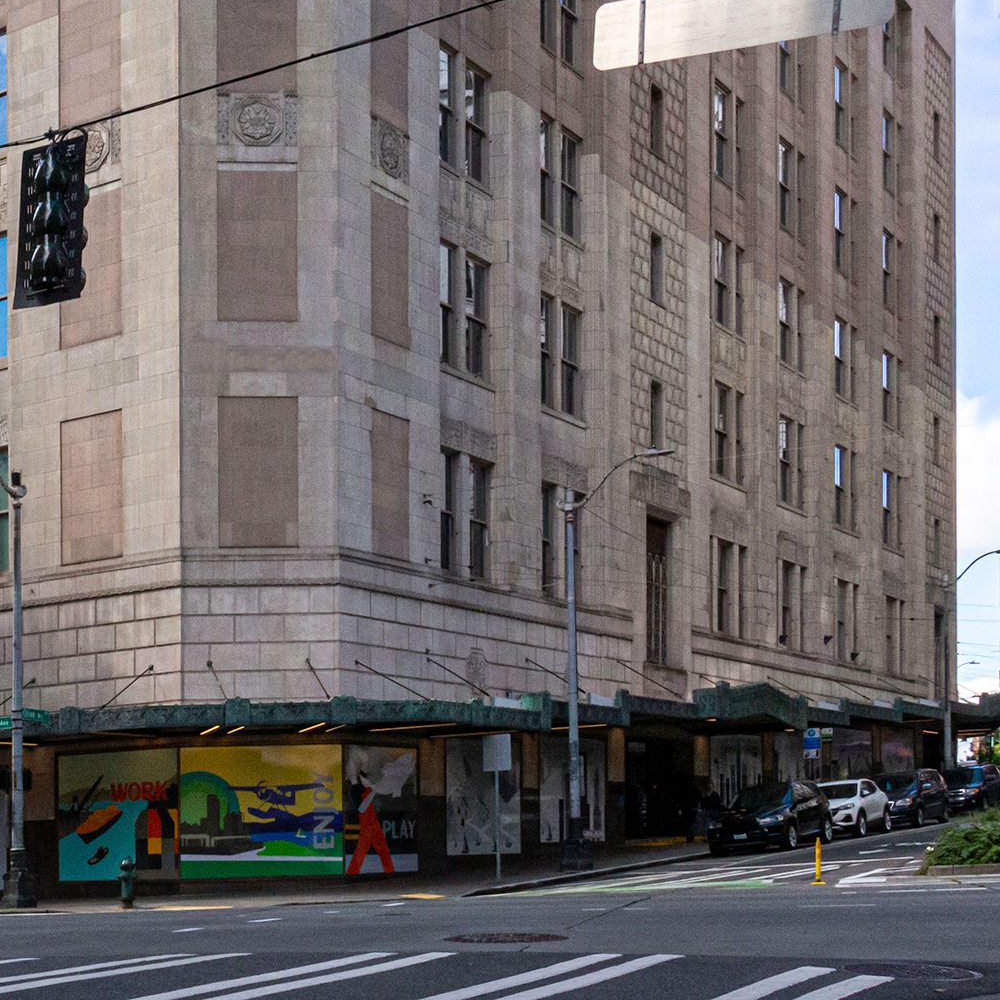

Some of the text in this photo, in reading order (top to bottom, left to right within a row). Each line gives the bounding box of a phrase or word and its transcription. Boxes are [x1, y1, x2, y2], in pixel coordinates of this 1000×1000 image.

[110, 780, 169, 802] WORK
[312, 770, 336, 849] ENJOY
[382, 820, 416, 839] PLAY
